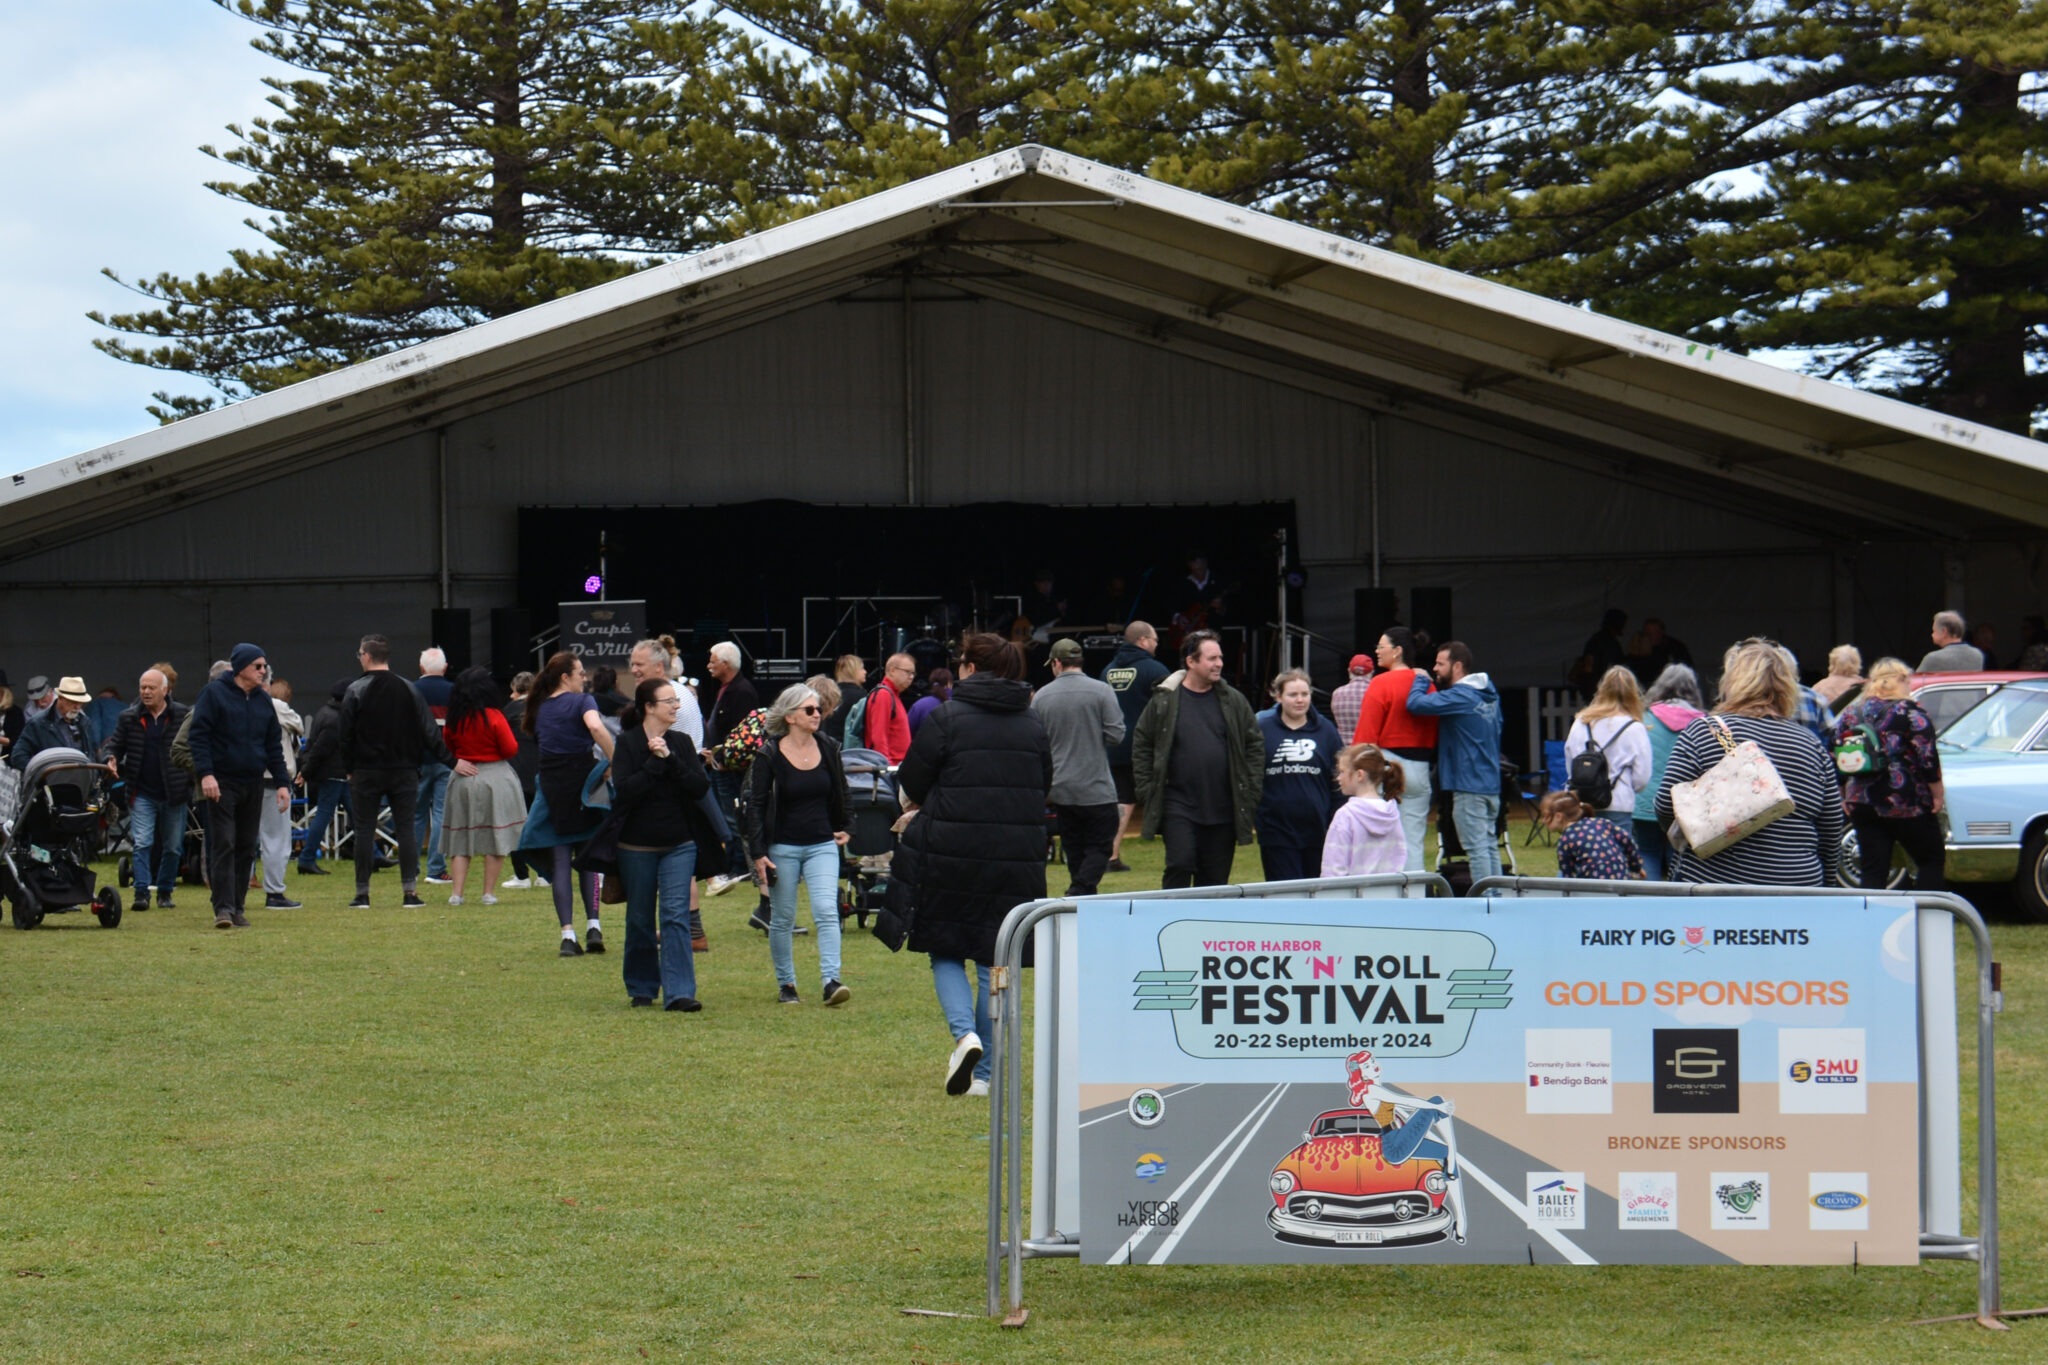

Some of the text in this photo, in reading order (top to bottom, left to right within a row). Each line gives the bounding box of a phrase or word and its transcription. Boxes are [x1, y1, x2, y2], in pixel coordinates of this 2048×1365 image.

[574, 621, 633, 637] Coupé
[1266, 764, 1321, 775] new balance
[1581, 928, 1810, 946] FAIRY PIG PRESENTS
[1202, 940, 1322, 952] VICTOR HARBOR
[1202, 955, 1293, 980] ROCK
[1354, 955, 1441, 980] ROLL
[1544, 980, 1849, 1006] GOLD SPONSORS
[1201, 984, 1445, 1025] FESTIVAL
[1214, 1033, 1433, 1051] 20-22 September 2024
[1815, 1059, 1858, 1074] 5MU
[1543, 1076, 1608, 1087] Bendigo Bank
[1607, 1136, 1787, 1150] BRONZE SPONSORS
[1538, 1194, 1576, 1205] BAILEY
[1817, 1196, 1859, 1205] CROWN
[1128, 1201, 1178, 1214] VICTOR
[1538, 1206, 1576, 1217] HOMES
[1117, 1213, 1178, 1226] HARBOR
[1337, 1231, 1353, 1241] ROCK
[1365, 1231, 1380, 1241] ROLL
